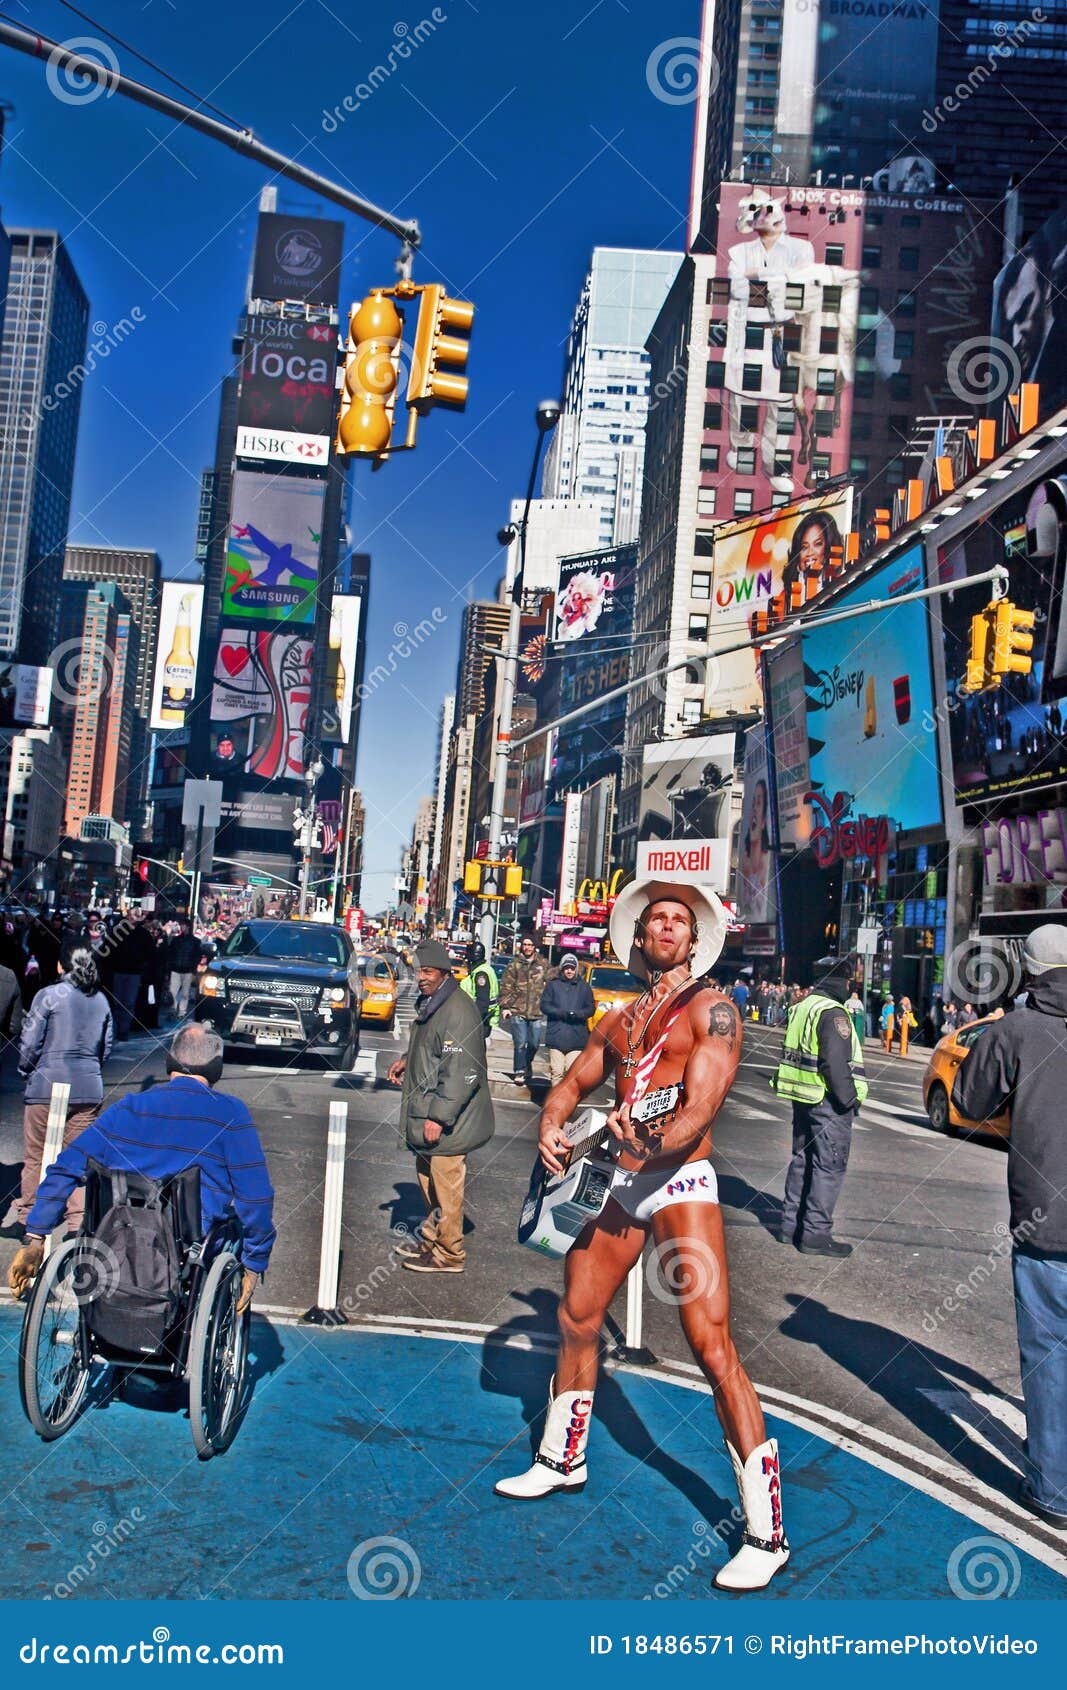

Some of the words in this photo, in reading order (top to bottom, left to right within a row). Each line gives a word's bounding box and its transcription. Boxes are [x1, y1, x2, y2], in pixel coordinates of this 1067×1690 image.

[829, 0, 928, 20] BROADWAY
[790, 190, 826, 204] 100%
[829, 191, 909, 209] Colombian
[913, 198, 965, 213] Coffee
[250, 317, 304, 339] HSBC
[242, 435, 294, 455] HSBC
[241, 589, 300, 604] SAMSUNG
[716, 569, 772, 608] OWN
[647, 847, 711, 872] maxell
[667, 1175, 708, 1196] NYC
